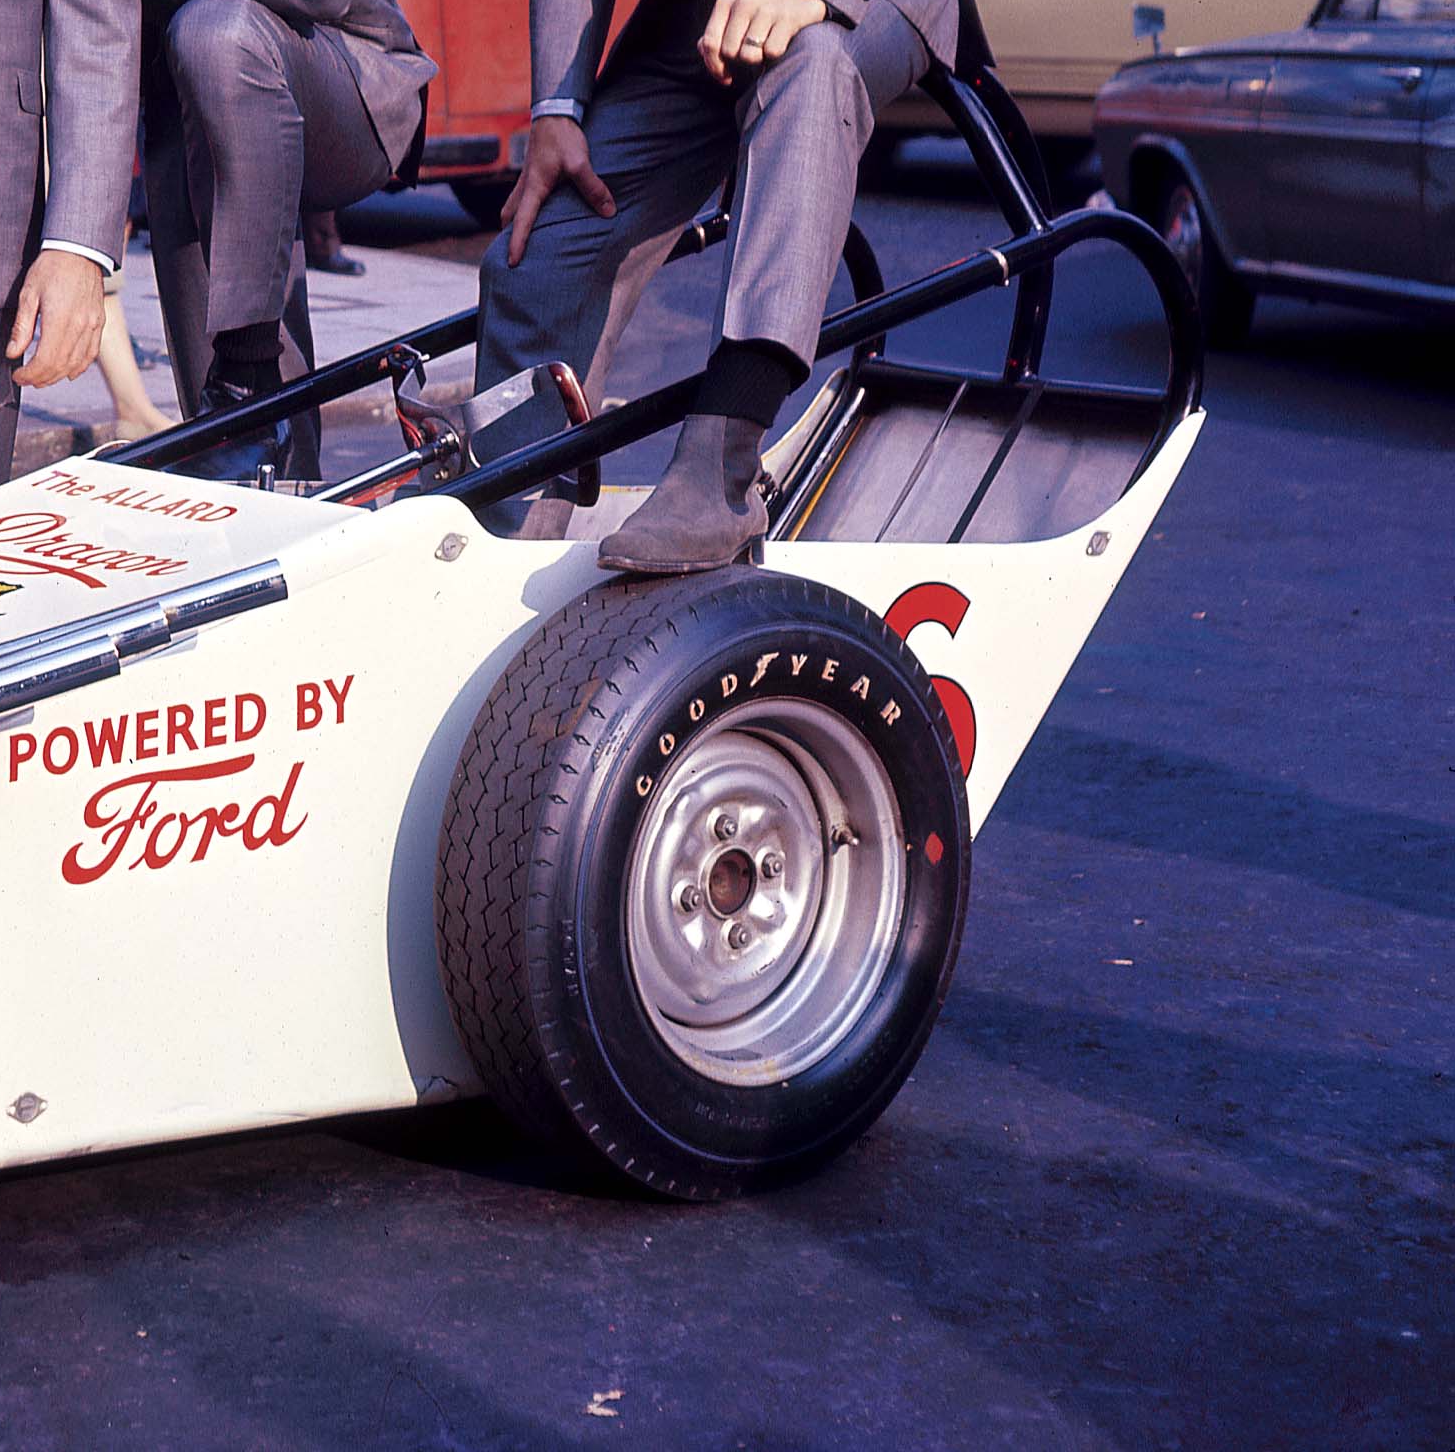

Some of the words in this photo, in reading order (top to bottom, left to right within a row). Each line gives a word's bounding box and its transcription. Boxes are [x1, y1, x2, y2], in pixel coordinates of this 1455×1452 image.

[31, 470, 95, 499] The
[90, 487, 239, 524] ALLARD
[9, 693, 267, 782] POWERED
[296, 674, 355, 731] BY
[61, 753, 308, 885] Ford
